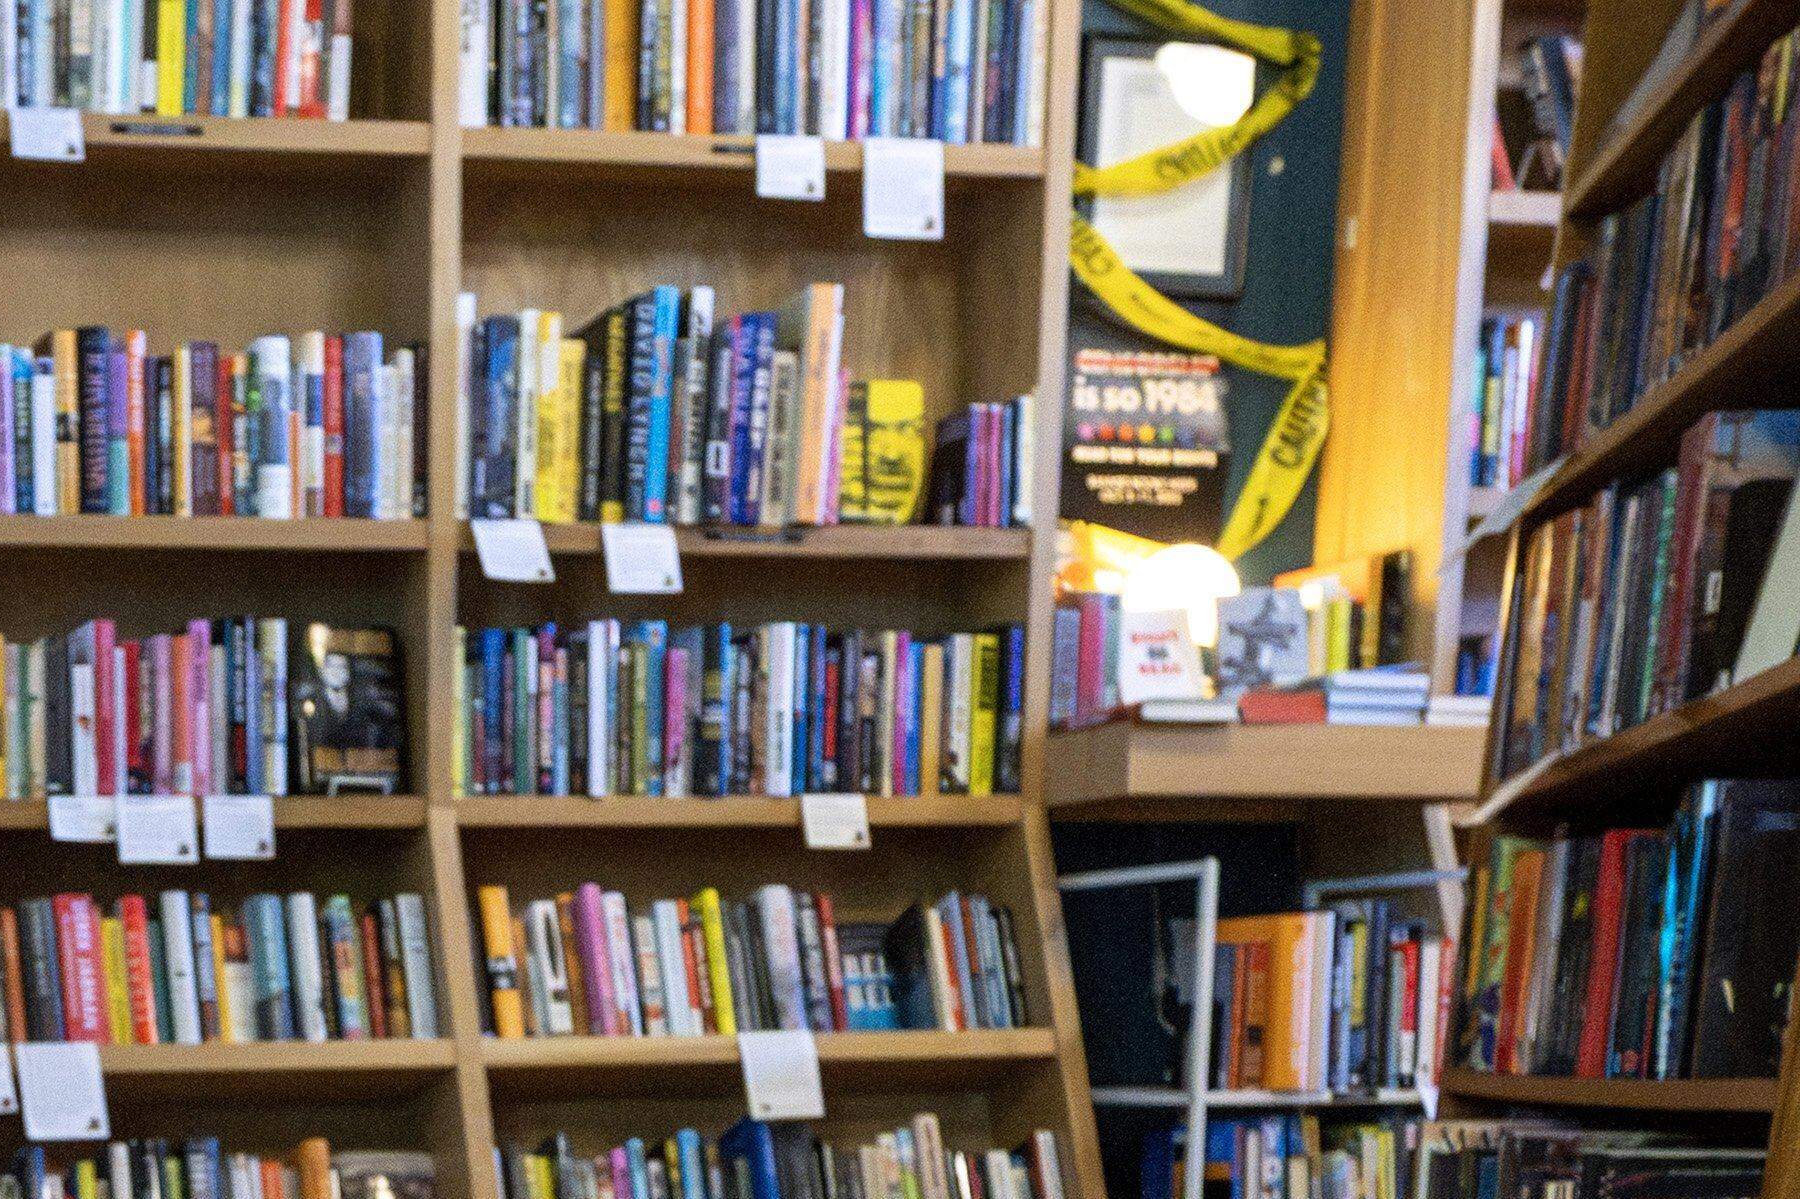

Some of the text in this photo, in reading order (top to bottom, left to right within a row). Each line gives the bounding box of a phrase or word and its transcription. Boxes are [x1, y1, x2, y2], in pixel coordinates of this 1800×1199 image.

[629, 303, 655, 479] DAVID LYNCH
[1073, 375, 1219, 416] is so 1984
